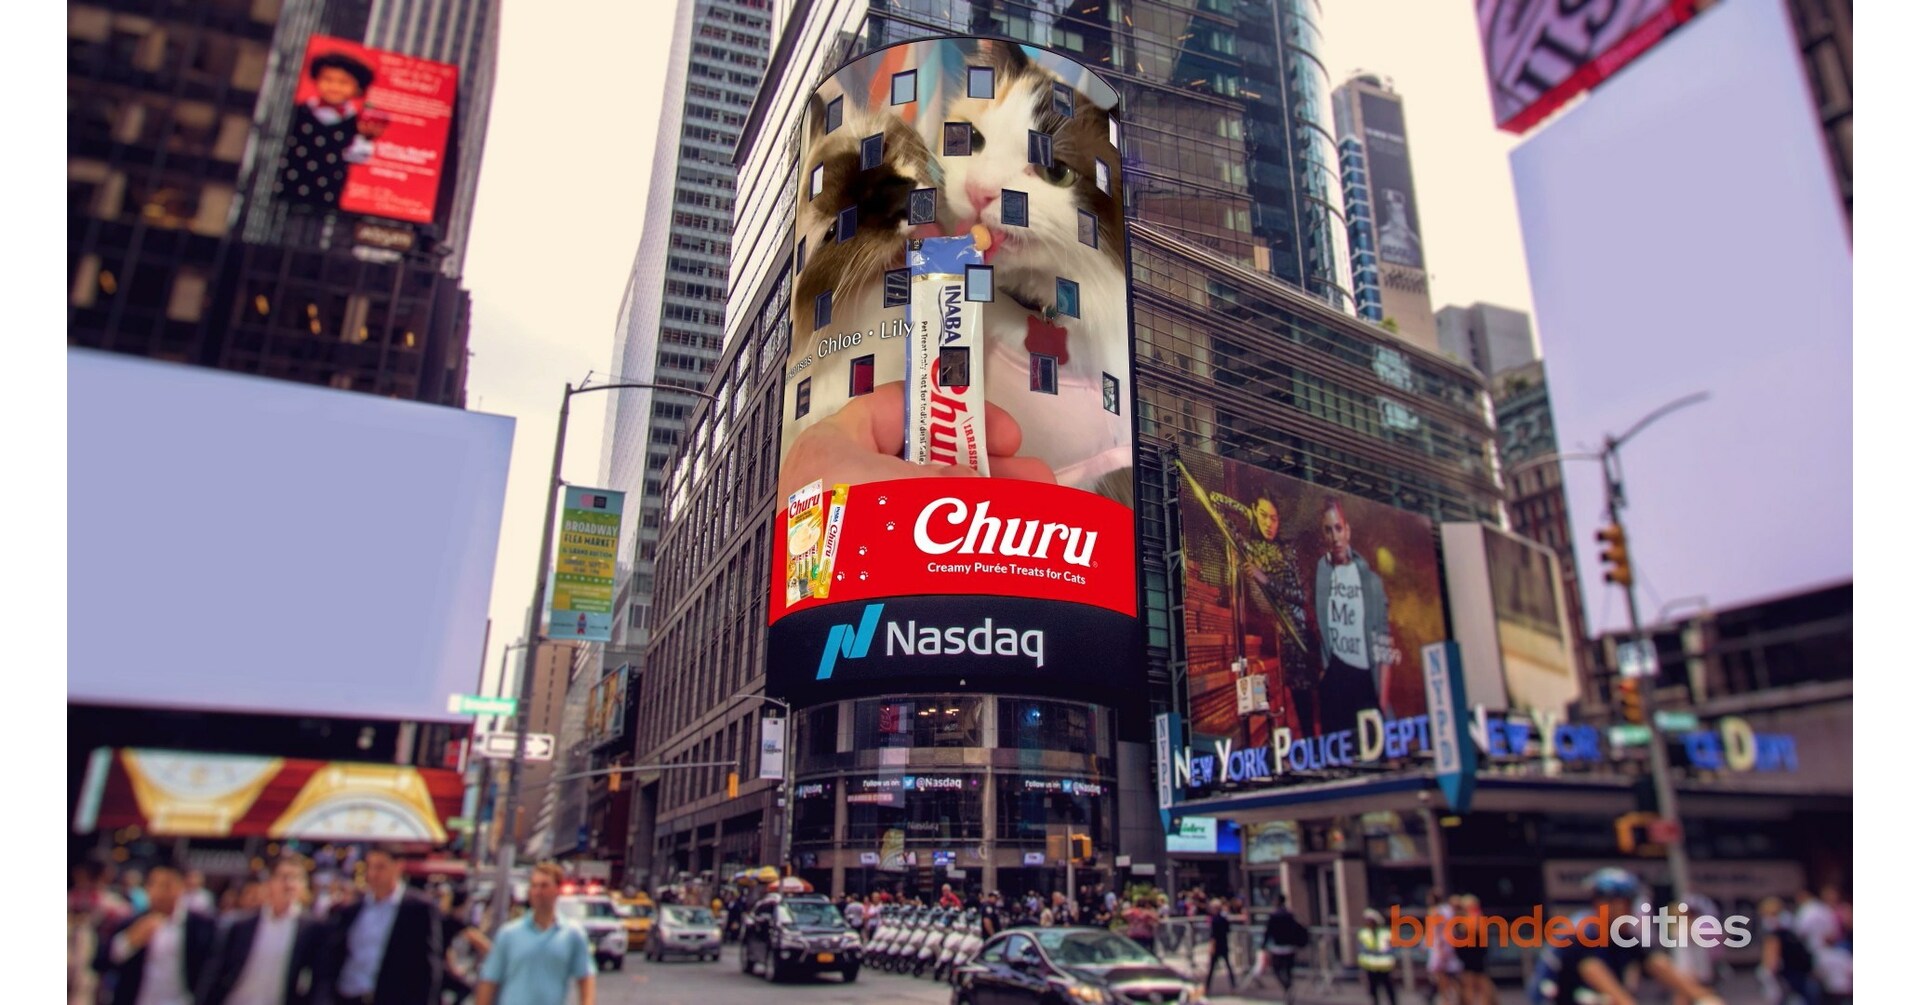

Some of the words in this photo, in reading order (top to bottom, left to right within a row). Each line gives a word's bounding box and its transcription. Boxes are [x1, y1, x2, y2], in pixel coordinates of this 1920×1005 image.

[920, 320, 929, 332] Pet
[944, 285, 962, 345] INABA
[818, 331, 862, 358] Chloe
[881, 319, 915, 338] Lily
[920, 332, 929, 352] Treat
[919, 390, 928, 404] for
[789, 493, 821, 519] Churu
[564, 520, 619, 537] BROADWAY
[564, 533, 582, 544] FLEA
[583, 536, 616, 548] MARKET
[825, 524, 838, 557] Churu
[913, 497, 1098, 567] Churu
[927, 562, 972, 574] Creamy
[974, 562, 1008, 574] Purée
[1009, 563, 1045, 578] Treats
[1046, 568, 1062, 580] for
[1063, 571, 1087, 585] Cats
[1328, 579, 1362, 600] Hear
[1330, 599, 1356, 626] Me
[886, 617, 1044, 668] Nasdaq
[1328, 626, 1361, 656] Roar
[1428, 648, 1452, 767] NYPD
[1158, 717, 1170, 805] NYPD
[1174, 745, 1214, 789] NEW
[1215, 738, 1270, 783] YORK
[1273, 727, 1354, 775] POLICE
[1356, 708, 1429, 762] DEPT
[916, 777, 962, 789] @Nasdaq
